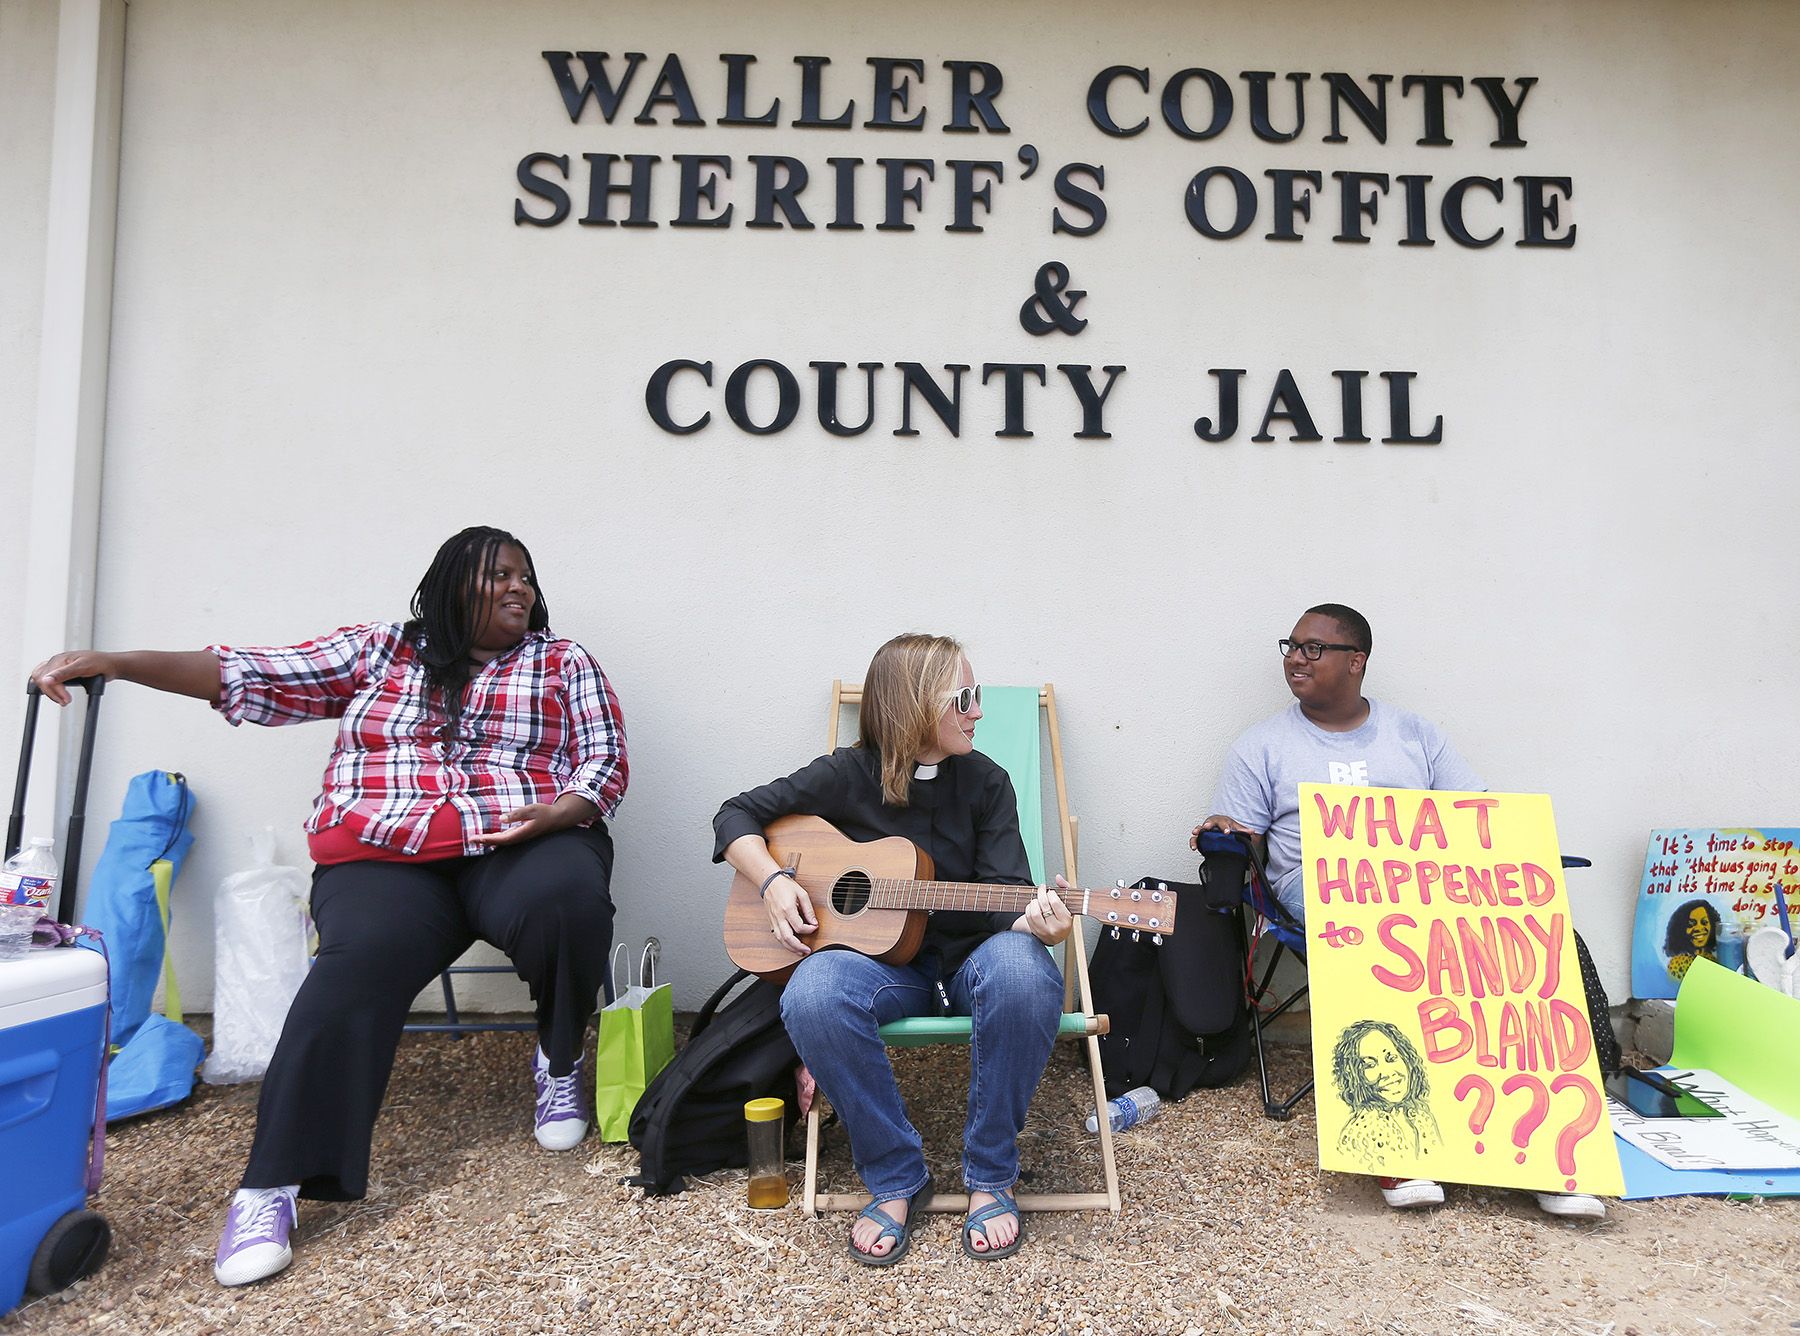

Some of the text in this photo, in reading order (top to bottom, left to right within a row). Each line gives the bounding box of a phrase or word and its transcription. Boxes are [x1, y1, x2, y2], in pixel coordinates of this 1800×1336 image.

[542, 50, 1539, 149] WALLER COUNTY
[514, 144, 1577, 250] SHERIFF'S OFFICE
[1020, 261, 1089, 337] &
[645, 359, 1443, 445] COUNTY JAIL
[1328, 760, 1369, 787] BE
[1313, 792, 1500, 852] WHAT
[1706, 833, 1738, 853] time
[1741, 835, 1756, 850] to
[1762, 837, 1794, 857] stop
[1315, 856, 1556, 908] HAPPENED
[1647, 878, 1672, 895] and
[1678, 874, 1698, 893] it's
[1704, 874, 1736, 894] time
[1738, 874, 1758, 894] to
[1649, 859, 1679, 878] that
[1719, 860, 1745, 874] was
[1746, 860, 1778, 880] going
[1782, 858, 1799, 875] to
[1731, 897, 1767, 920] doing
[1317, 912, 1565, 1001] to SANDY
[1416, 996, 1593, 1073] BLAND
[1666, 1071, 1746, 1116] What
[1453, 1073, 1603, 1193] ???
